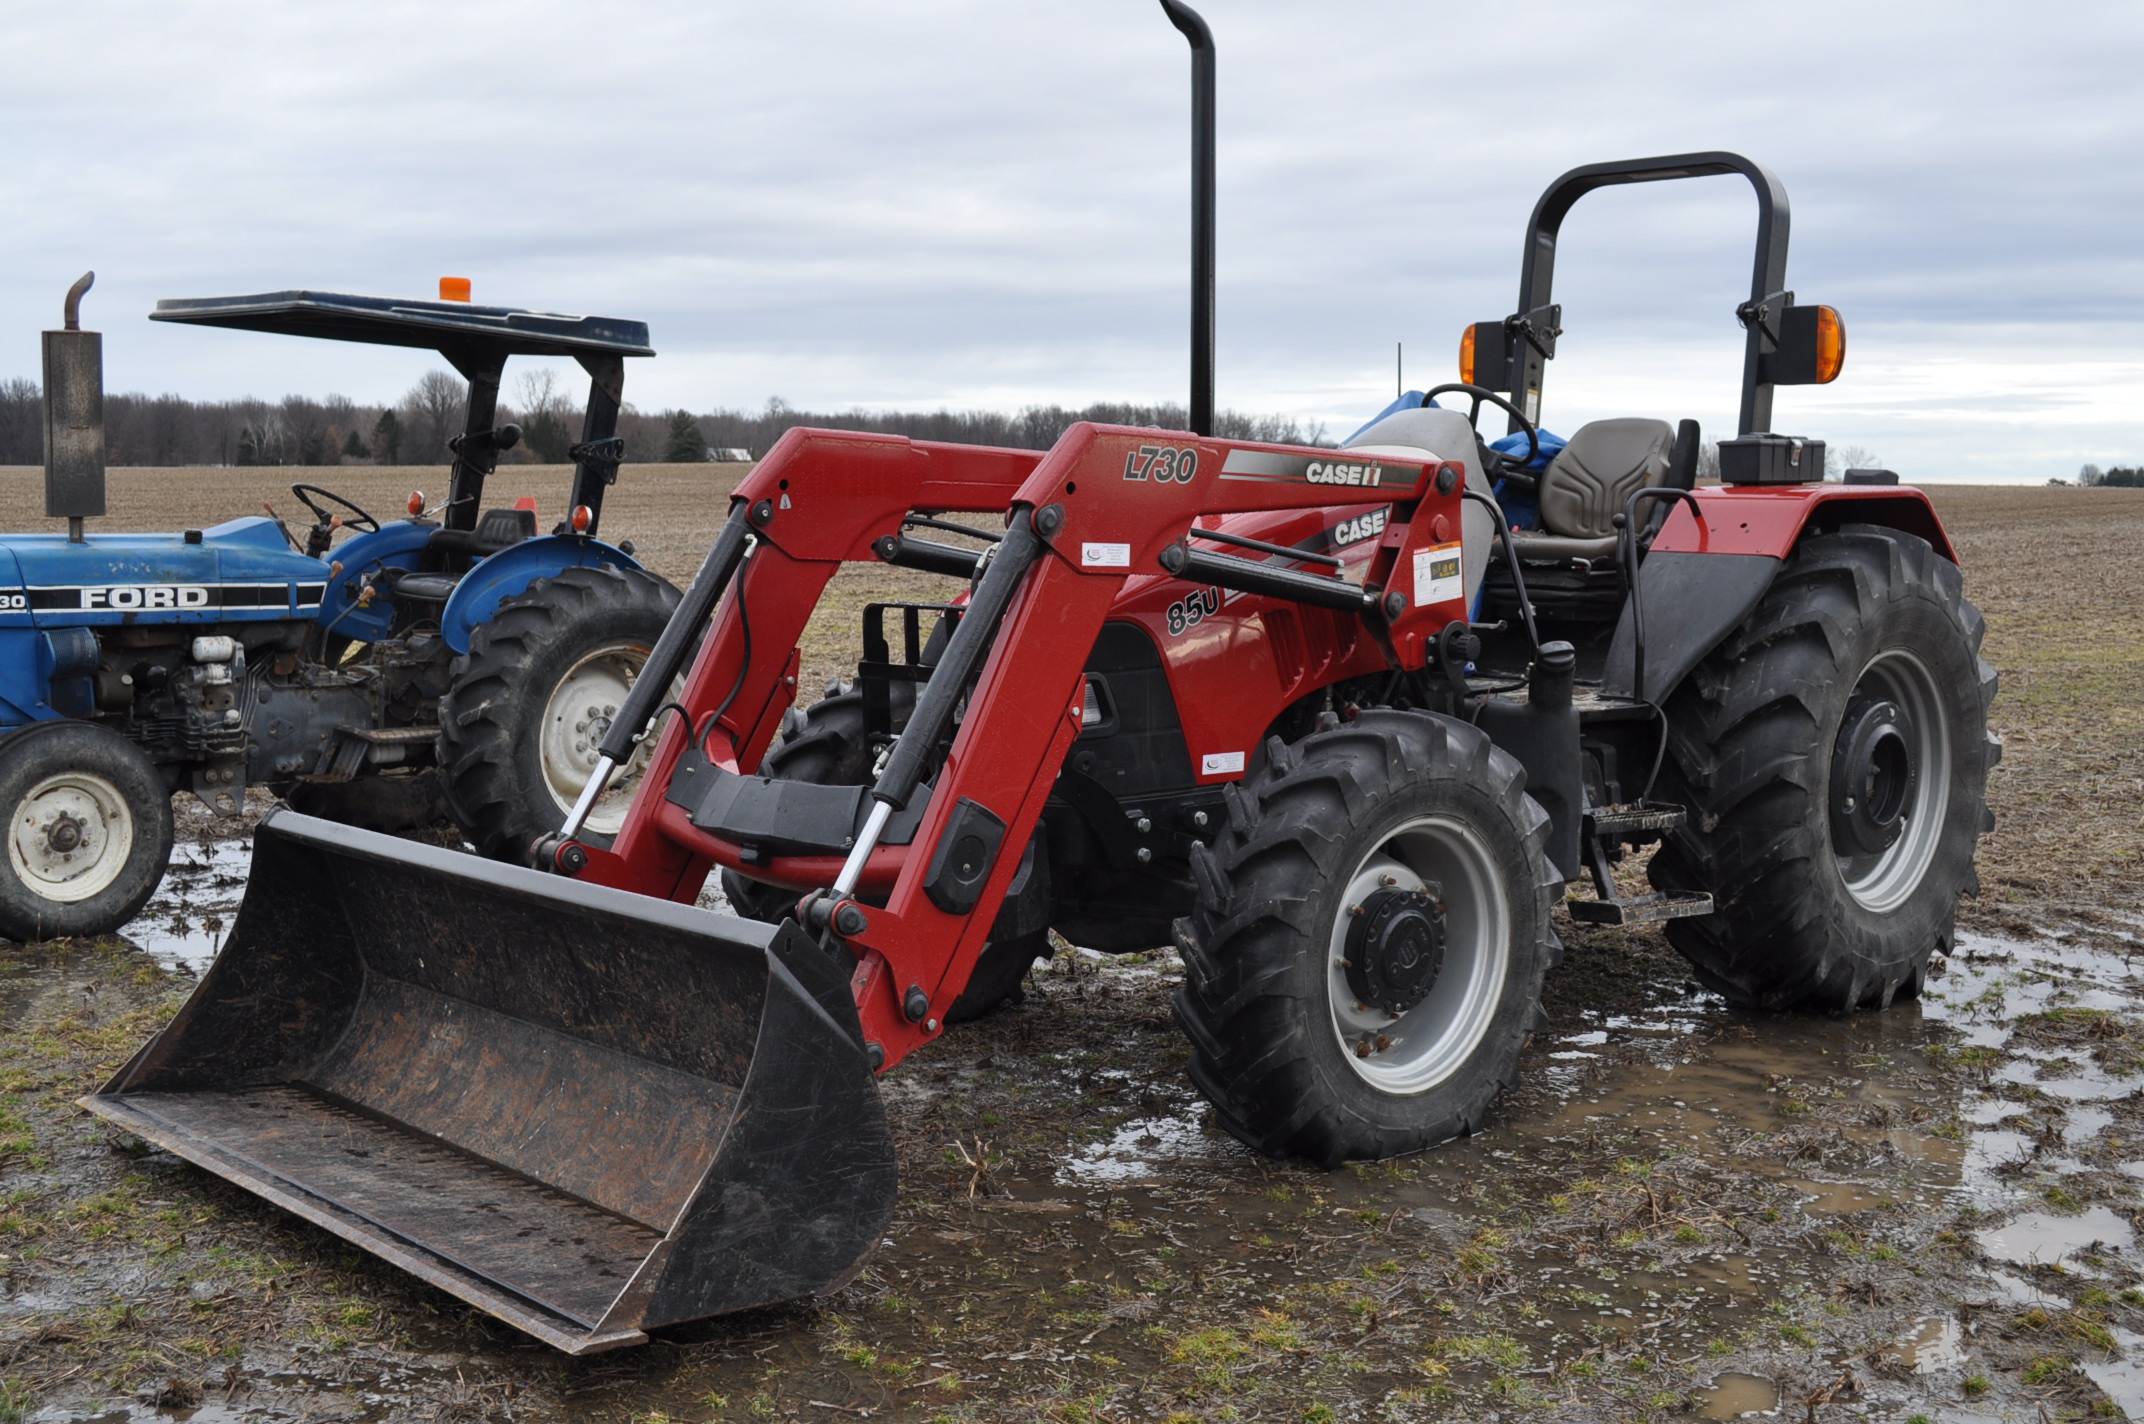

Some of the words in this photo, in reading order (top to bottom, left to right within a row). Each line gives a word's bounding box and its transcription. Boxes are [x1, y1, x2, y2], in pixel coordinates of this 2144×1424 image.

[1123, 445, 1198, 484] L730
[1335, 511, 1385, 545] CASE
[81, 587, 208, 608] FORD
[1166, 586, 1219, 636] 85U
